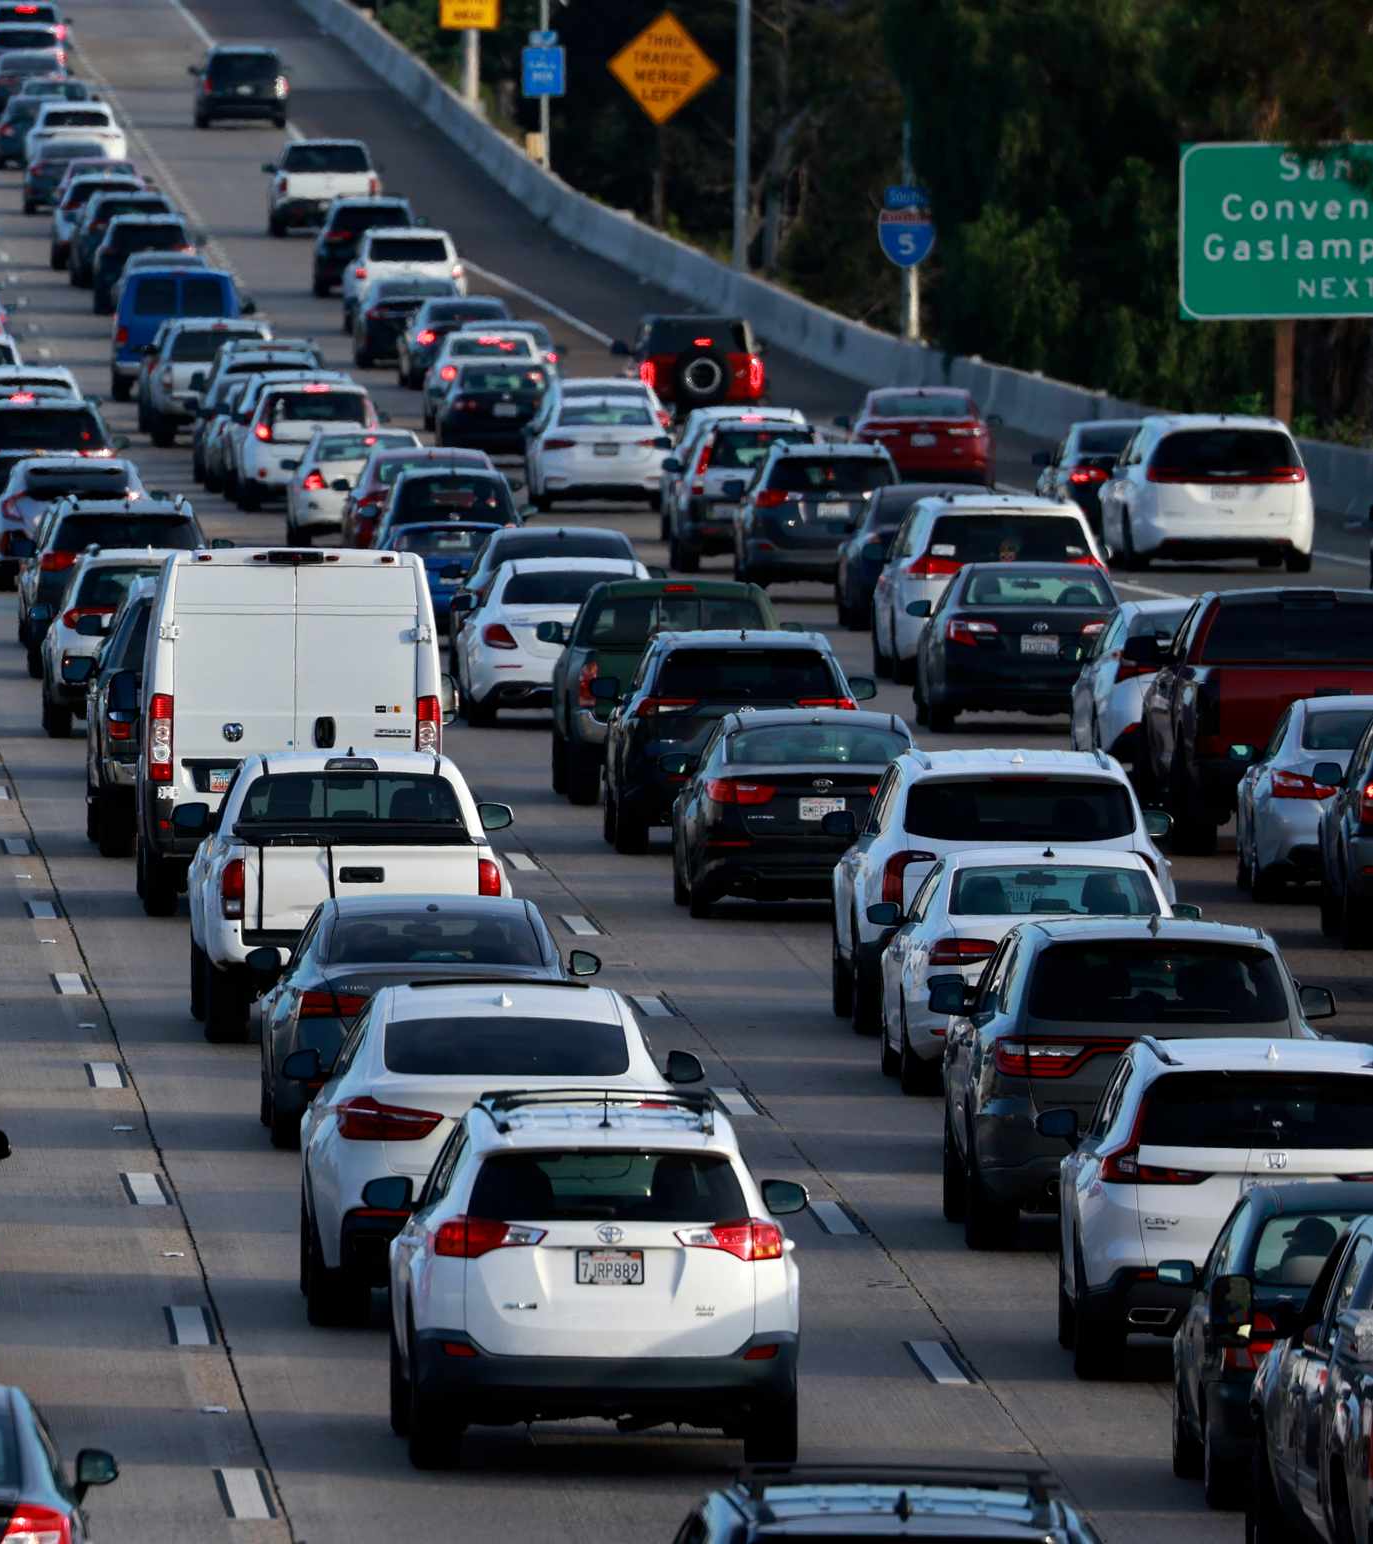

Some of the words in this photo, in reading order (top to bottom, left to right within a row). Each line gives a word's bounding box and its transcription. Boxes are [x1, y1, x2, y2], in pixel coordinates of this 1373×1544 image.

[647, 34, 684, 49] THRU
[634, 50, 693, 66] TRAFFIC
[634, 68, 692, 85] MERGE
[642, 86, 682, 102] LEFT
[1222, 194, 1369, 221] Conven
[898, 233, 916, 255] 5
[1203, 233, 1373, 265] Gaslamp
[581, 1262, 640, 1280] 7JRP889
